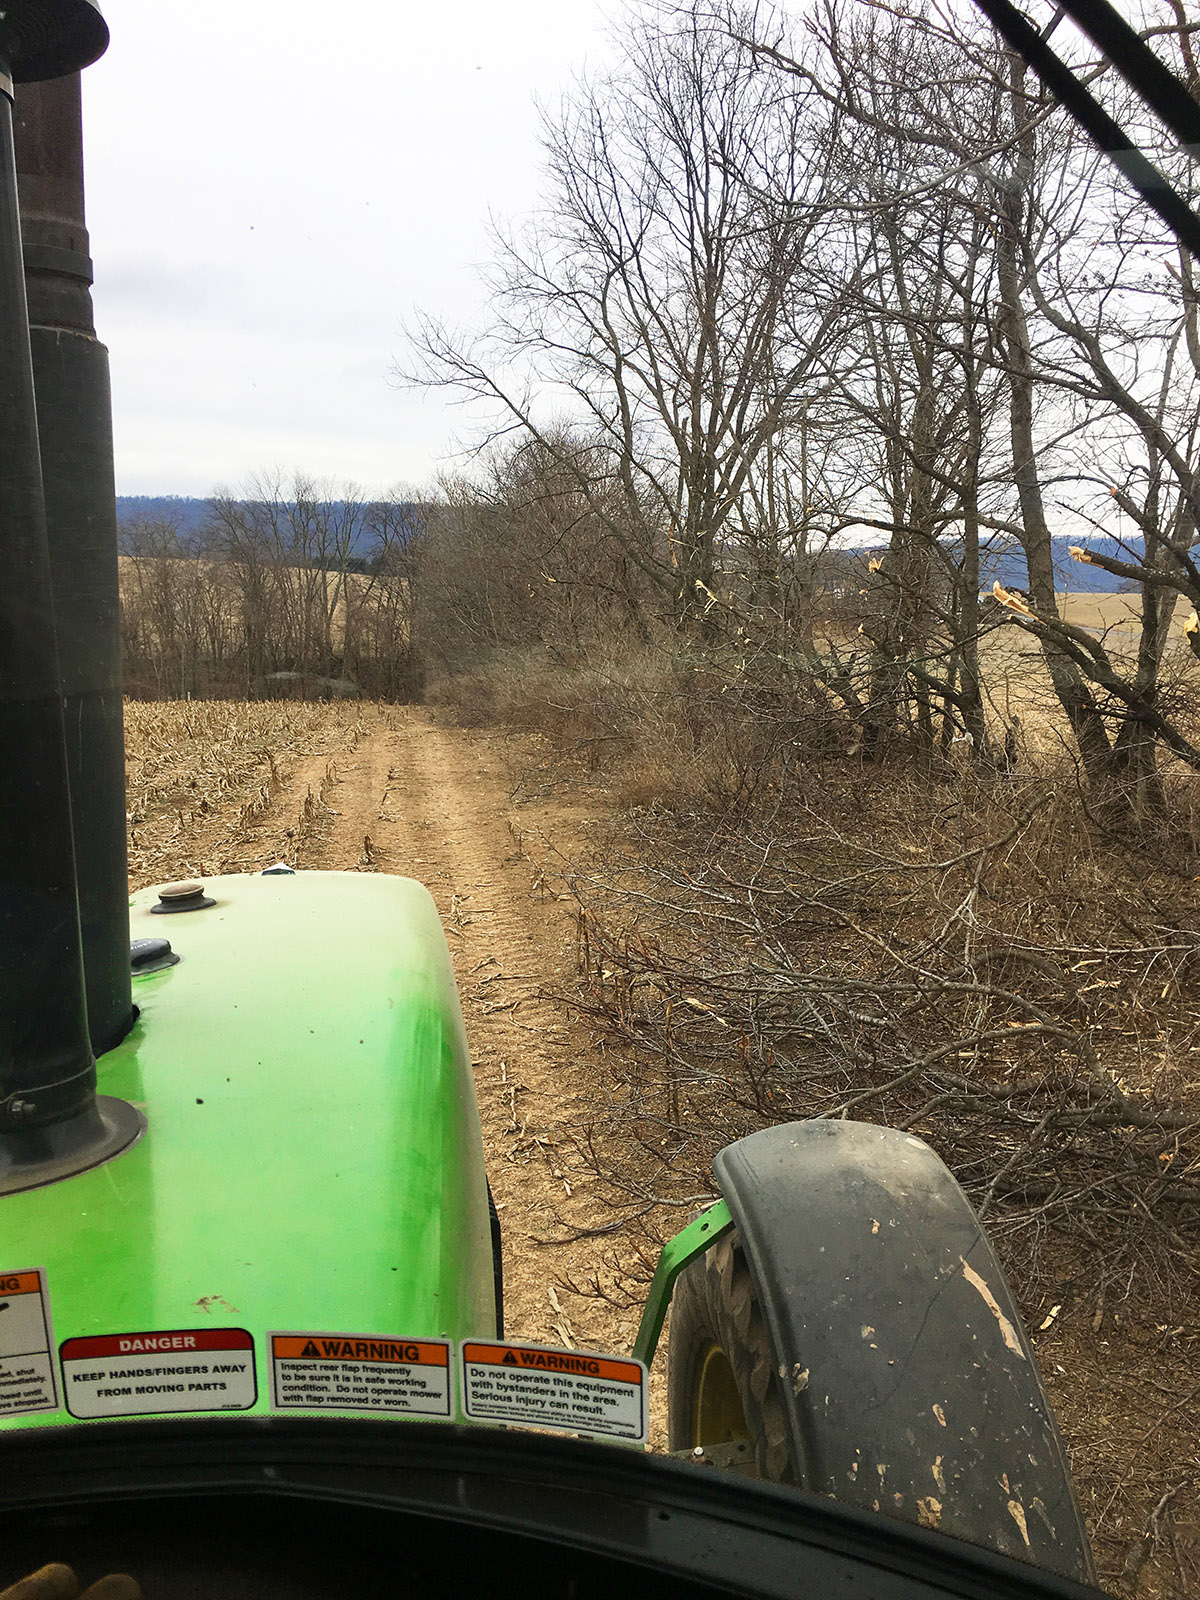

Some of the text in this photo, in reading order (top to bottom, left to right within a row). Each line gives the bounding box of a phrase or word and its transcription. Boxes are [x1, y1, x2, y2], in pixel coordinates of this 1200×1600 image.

[119, 1336, 196, 1351] DANGER
[321, 1341, 420, 1362] WARNING
[281, 1363, 318, 1372] Inspect
[341, 1364, 360, 1374] flap
[362, 1365, 411, 1377] frequently
[520, 1352, 600, 1374] WARNING
[73, 1364, 247, 1382] KEEP HANDS/FINGERS AWAY
[97, 1382, 227, 1397] FROM MOVING PARTS
[333, 1374, 340, 1382] it
[353, 1375, 363, 1383] in
[387, 1378, 427, 1389] working
[470, 1368, 635, 1398] Do not operate this equipment
[282, 1384, 443, 1399] condition. Do not operate mower
[470, 1380, 619, 1407] with bystanders in the area.
[282, 1394, 304, 1402] with
[306, 1394, 324, 1404] flap
[326, 1396, 369, 1404] removed
[384, 1399, 411, 1407] worn.
[471, 1391, 513, 1403] Serious
[515, 1395, 546, 1408] injury
[549, 1400, 569, 1411] can
[571, 1403, 606, 1416] result.
